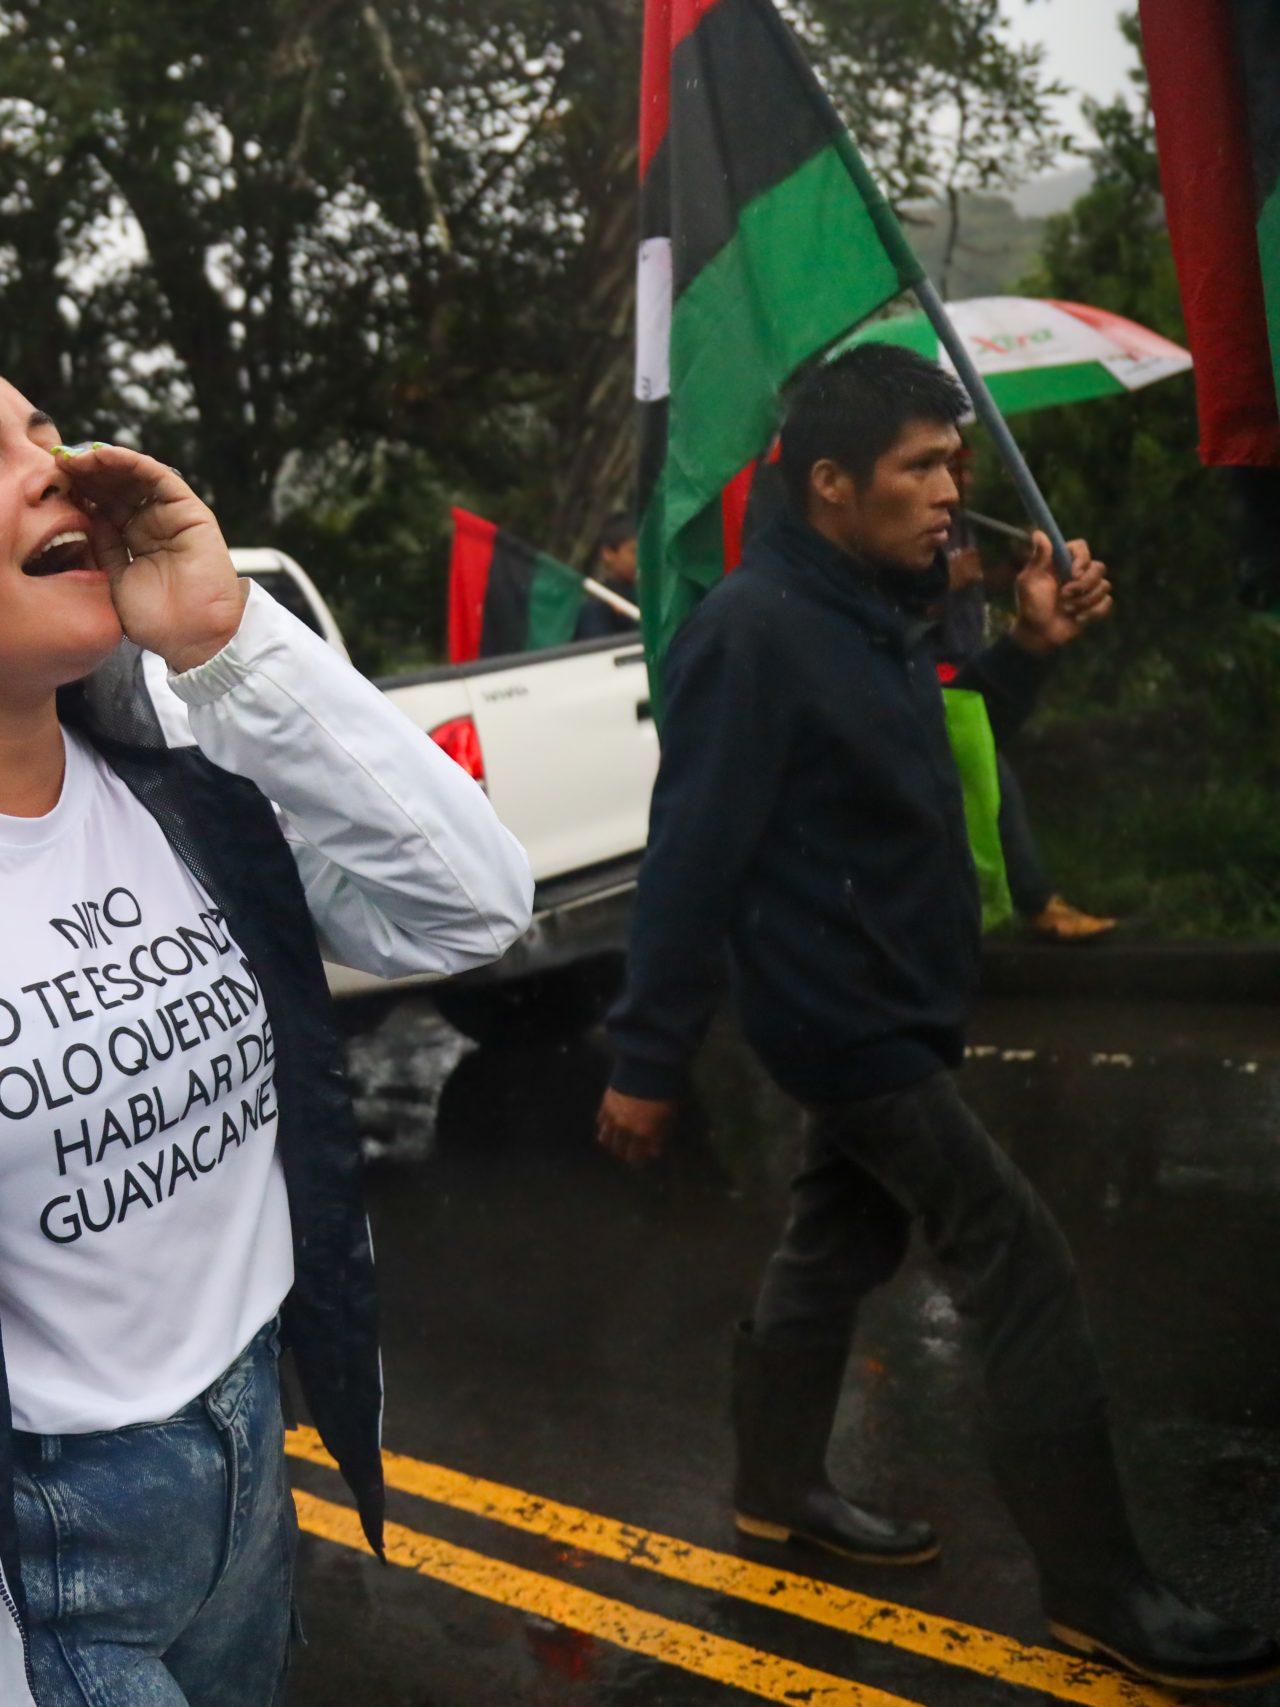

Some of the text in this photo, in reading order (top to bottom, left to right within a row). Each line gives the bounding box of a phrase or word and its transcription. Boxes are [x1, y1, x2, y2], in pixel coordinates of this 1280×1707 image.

[48, 886, 142, 949] NITO
[21, 970, 94, 1029] TE
[53, 1016, 275, 1175] HABLAR DE
